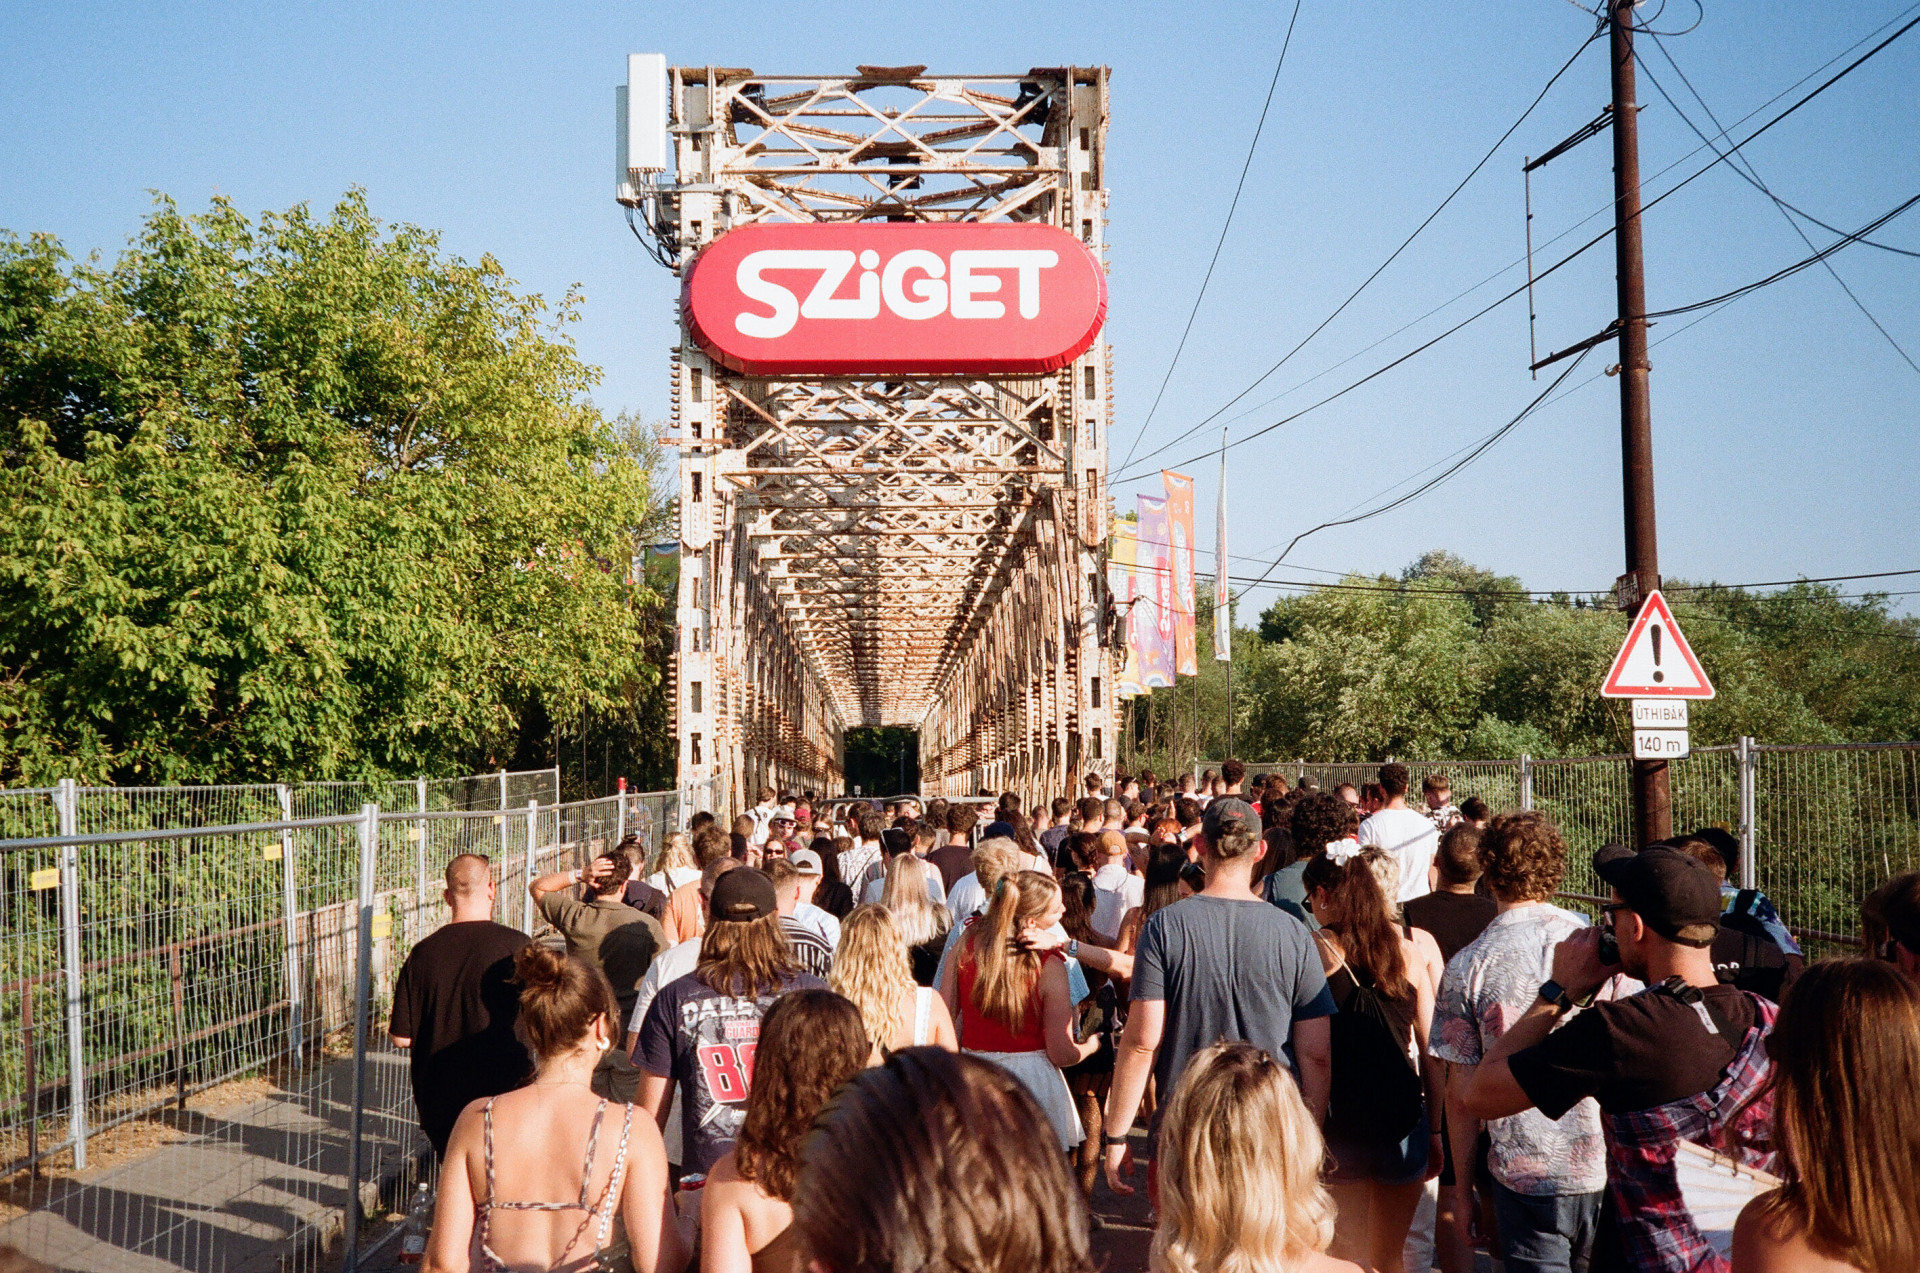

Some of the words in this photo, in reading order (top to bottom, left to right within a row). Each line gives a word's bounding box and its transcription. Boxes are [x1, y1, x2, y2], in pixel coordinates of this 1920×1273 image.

[1636, 704, 1685, 720] ÚTHIBÁK
[1639, 736, 1661, 752] 140
[1666, 740, 1681, 752] m
[726, 1027, 760, 1038] GUARD
